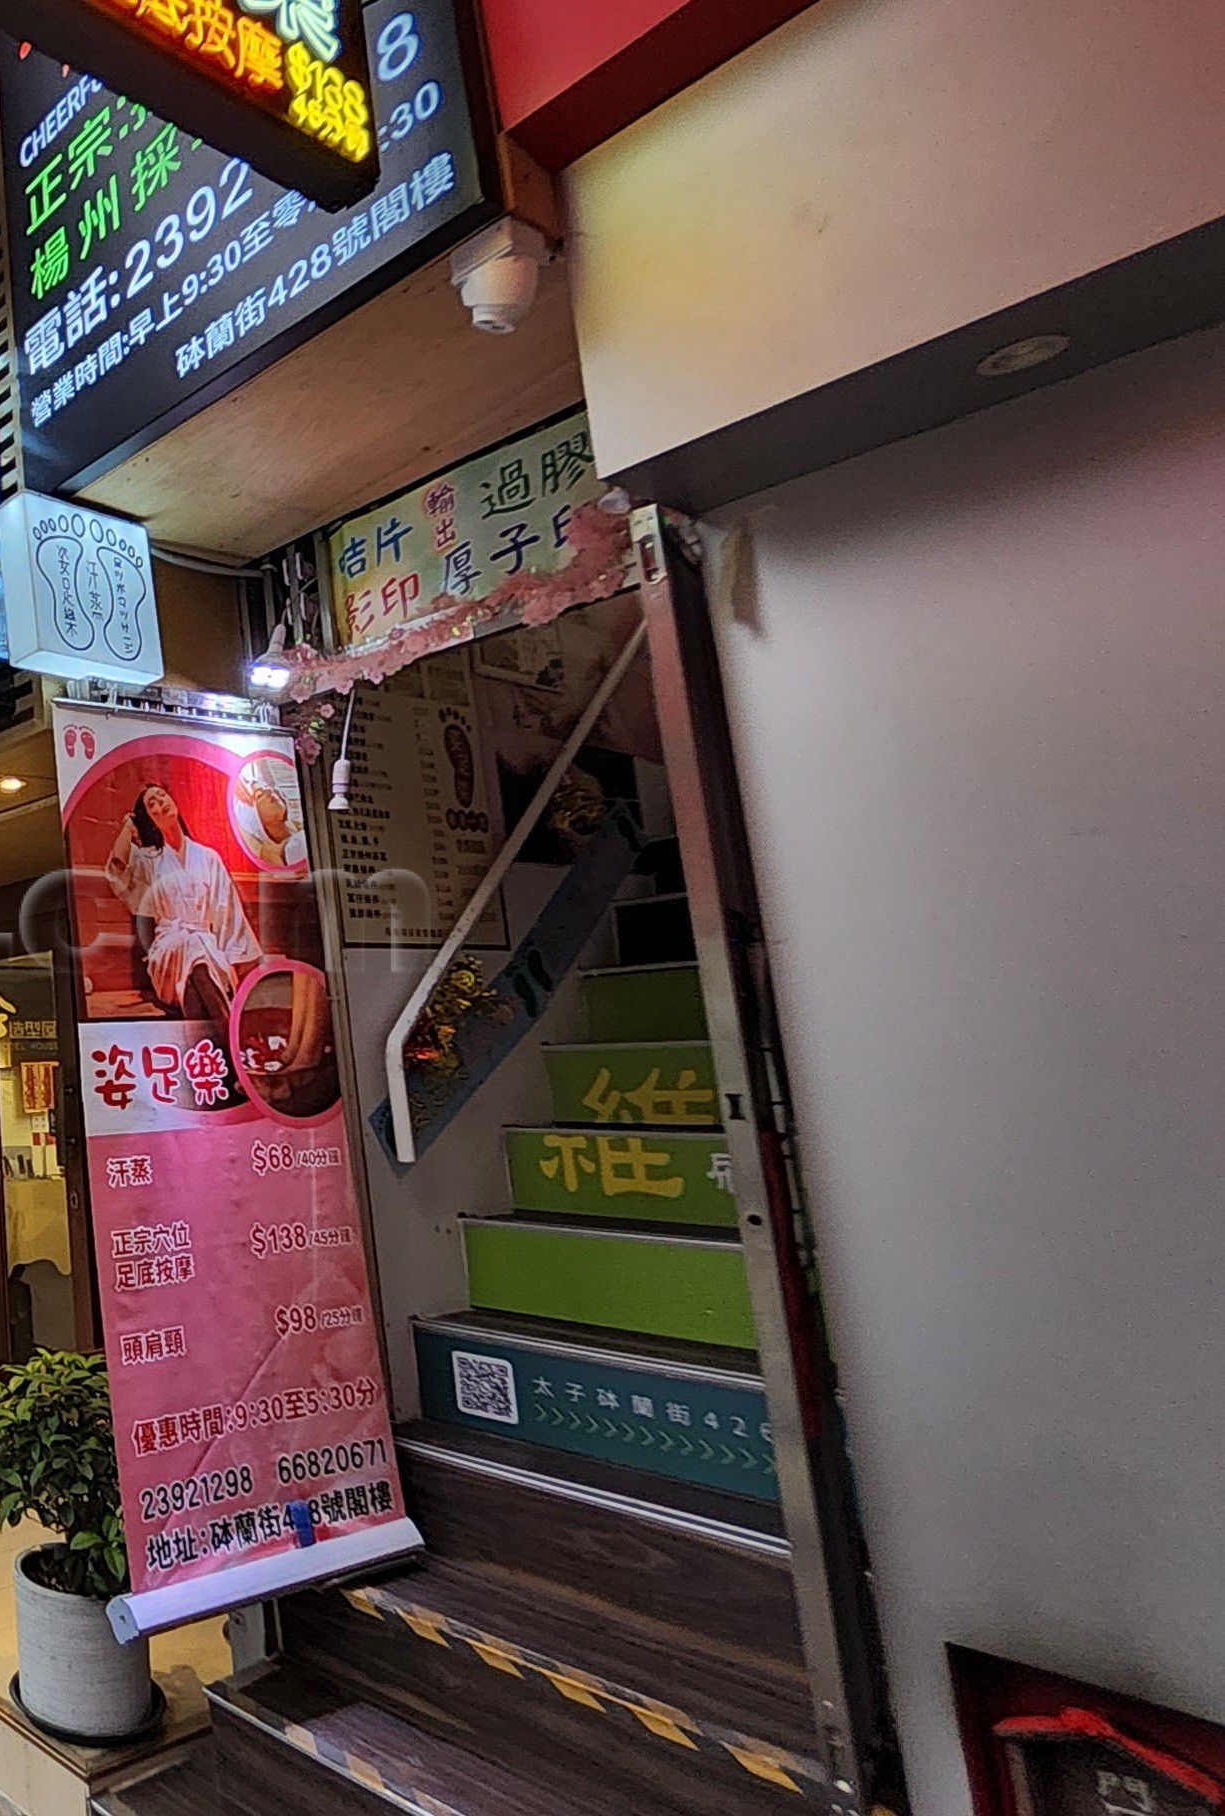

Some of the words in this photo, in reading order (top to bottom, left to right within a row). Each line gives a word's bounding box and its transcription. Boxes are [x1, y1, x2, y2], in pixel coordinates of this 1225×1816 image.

[30, 123, 203, 300] 楊州採
[175, 151, 456, 378] 砵蘭街428號閣樓
[480, 431, 594, 520] 過膠
[91, 1039, 229, 1110] 姿足樂
[106, 1154, 154, 1188] 汗蒸
[111, 1221, 192, 1259] 正宗穴位
[115, 1254, 196, 1292] 足底按摩
[120, 1325, 187, 1365] 頭肩頸
[140, 1466, 254, 1521] 23921298
[277, 1437, 388, 1485] 66820671
[146, 1479, 394, 1571] 地址:砵蘭街48號閣樓
